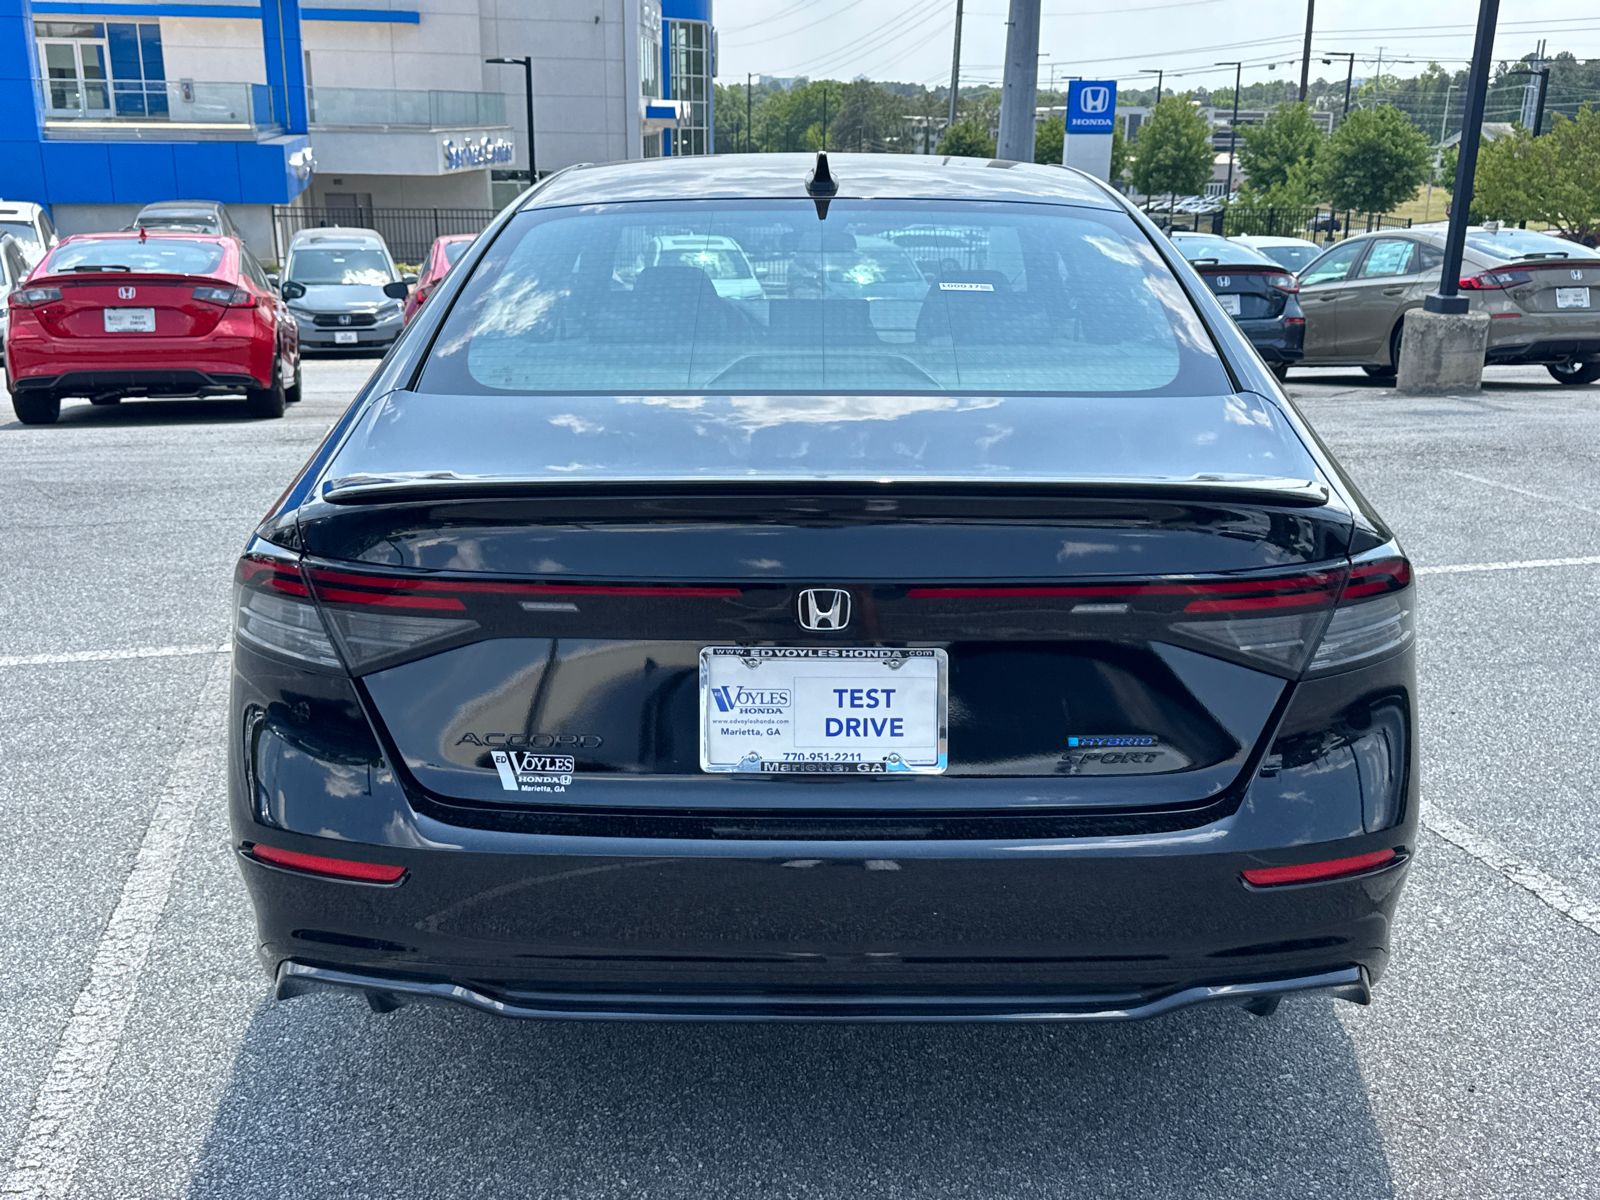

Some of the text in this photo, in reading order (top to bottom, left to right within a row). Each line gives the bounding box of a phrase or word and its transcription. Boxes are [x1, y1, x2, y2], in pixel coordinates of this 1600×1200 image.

[1071, 118, 1113, 126] HONDA
[721, 685, 789, 710] VOYLES
[832, 688, 897, 709] TEST
[739, 707, 784, 715] HONDA
[712, 718, 790, 726] www.edvoyleshonda.com
[720, 727, 782, 737] Marietta, GA
[824, 717, 905, 738] DRIVE
[455, 732, 604, 749] ACCORD
[1080, 737, 1154, 746] HYBRID
[495, 755, 507, 764] ED
[782, 752, 862, 761] 770-951-2211
[1056, 751, 1166, 765] SPORT
[508, 751, 574, 775] VOYLES
[763, 762, 884, 773] Marietta, GA
[517, 775, 560, 784] HONDA
[520, 784, 566, 794] Marietta, GA
